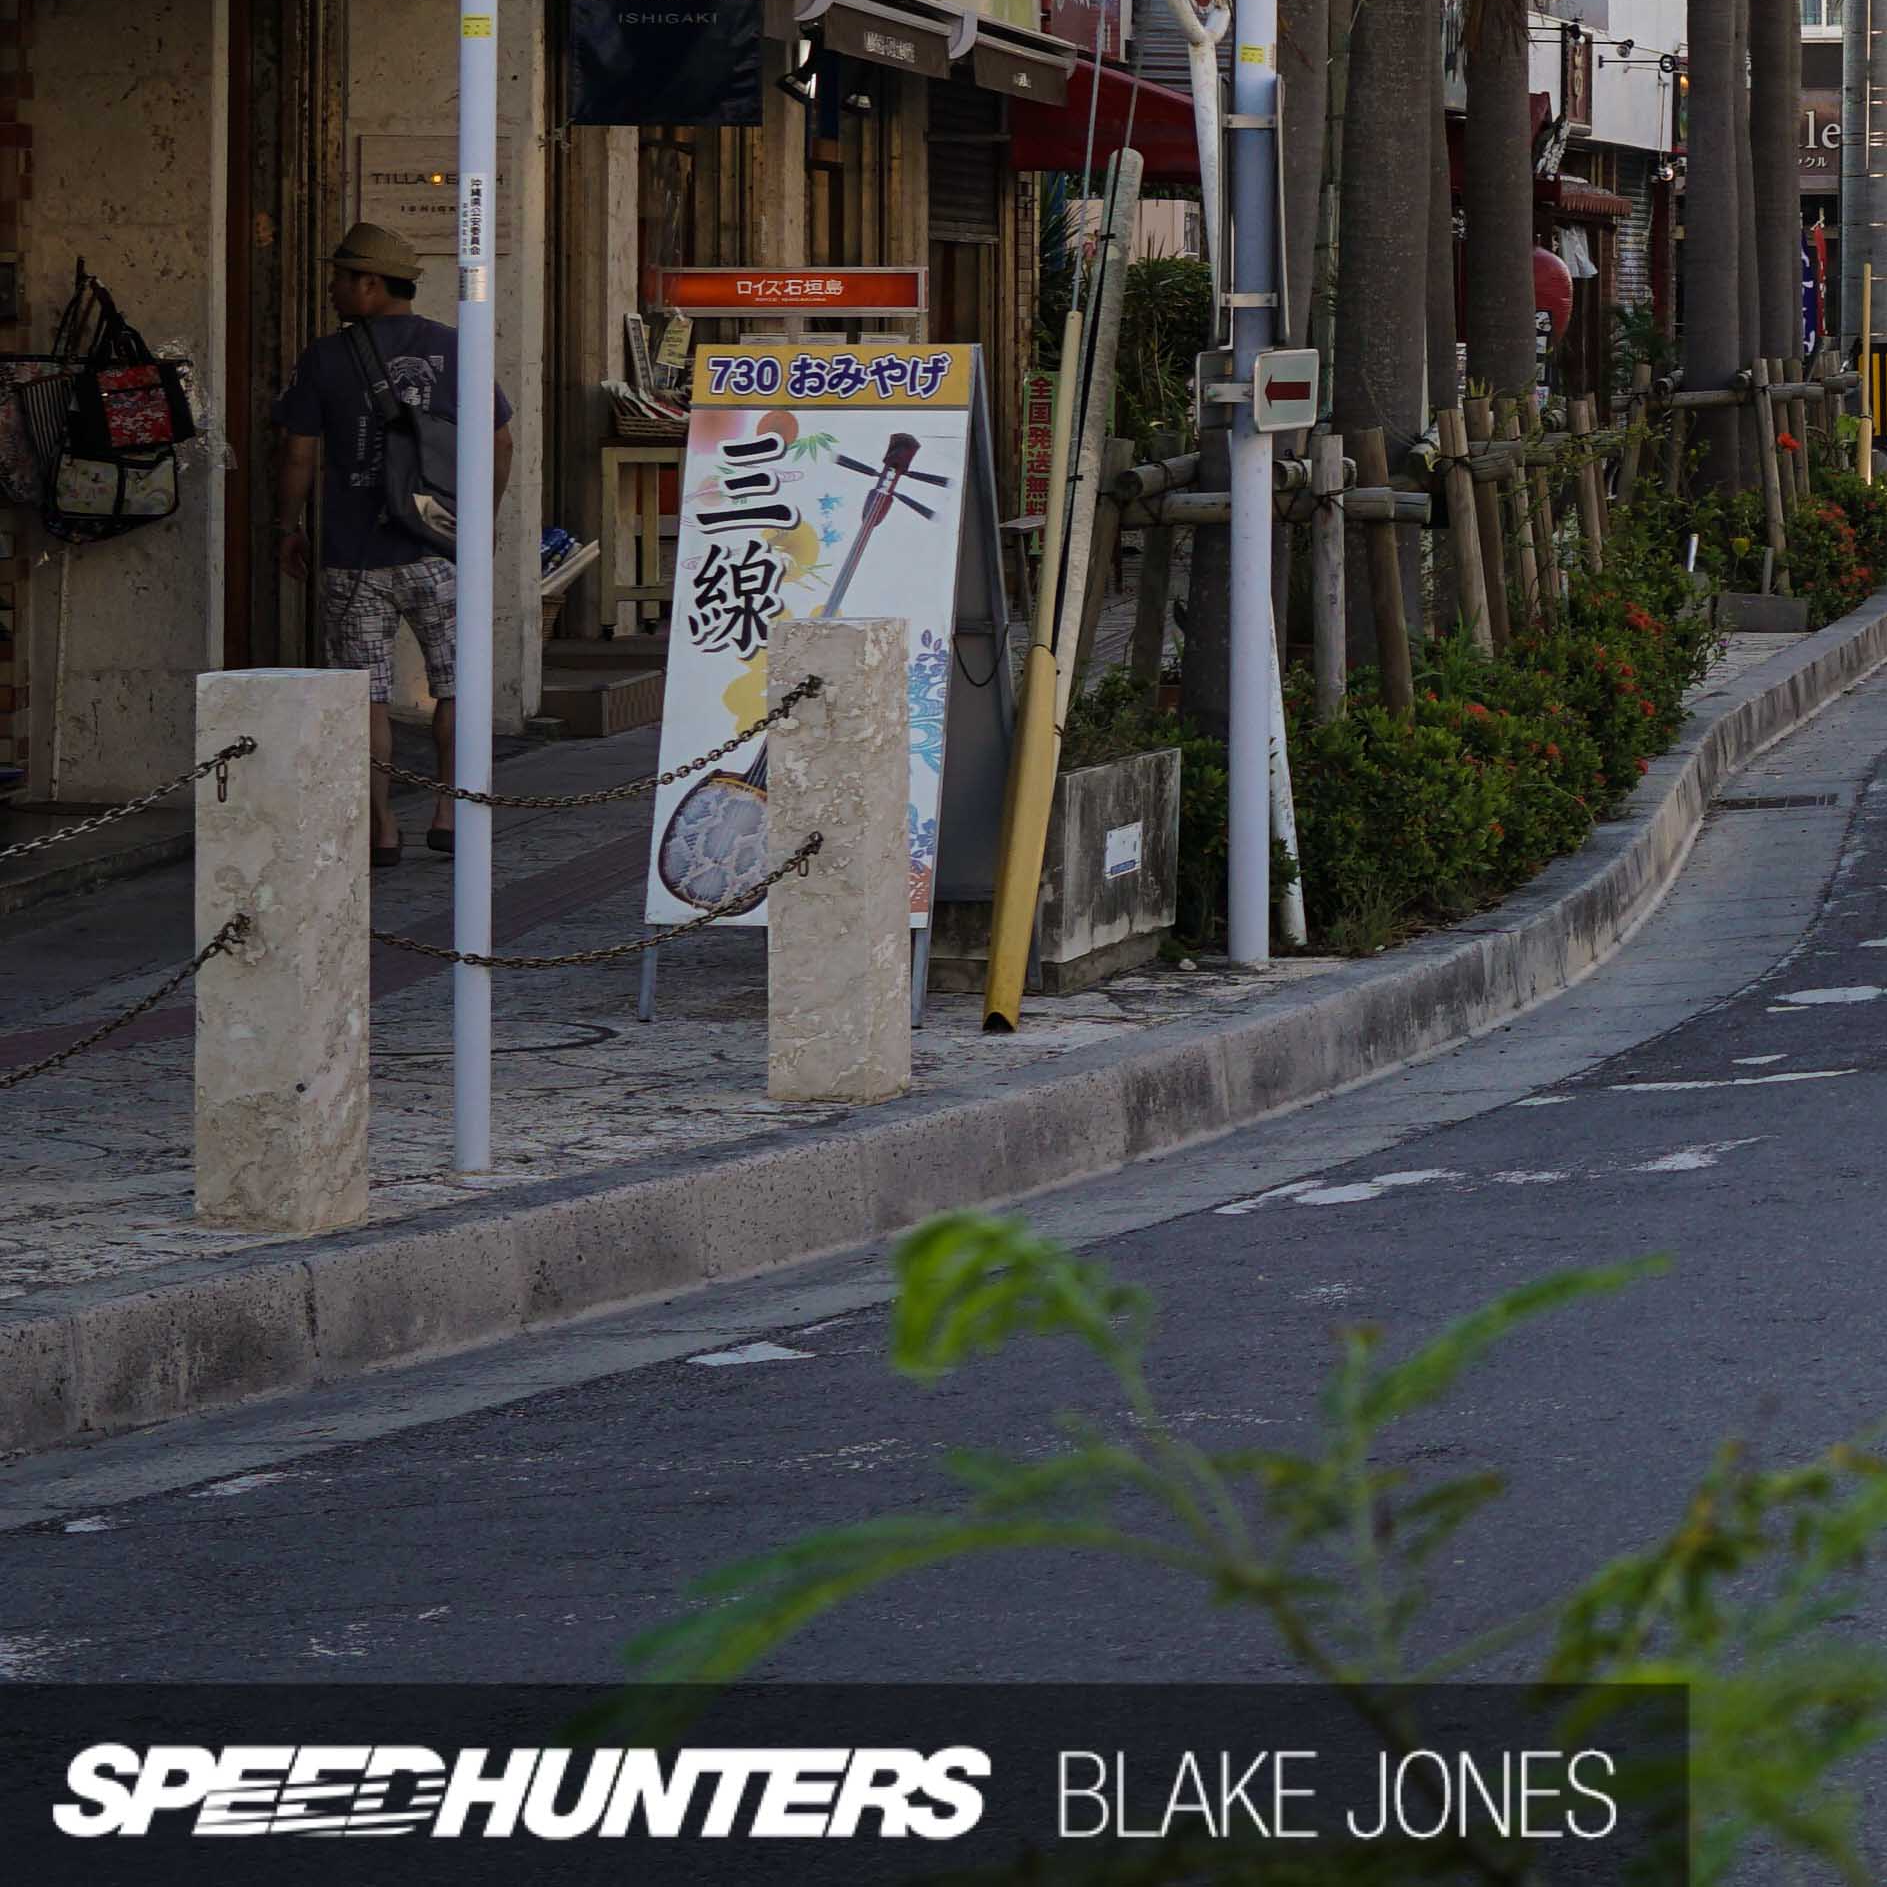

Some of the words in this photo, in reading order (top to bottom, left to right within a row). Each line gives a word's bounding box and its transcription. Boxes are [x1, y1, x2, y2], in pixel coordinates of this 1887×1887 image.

[619, 13, 719, 25] ISHIGAKI
[735, 279, 845, 296] ロイズ石垣島
[708, 355, 782, 396] 730
[787, 352, 952, 401] おみやげ
[688, 431, 800, 659] 三線
